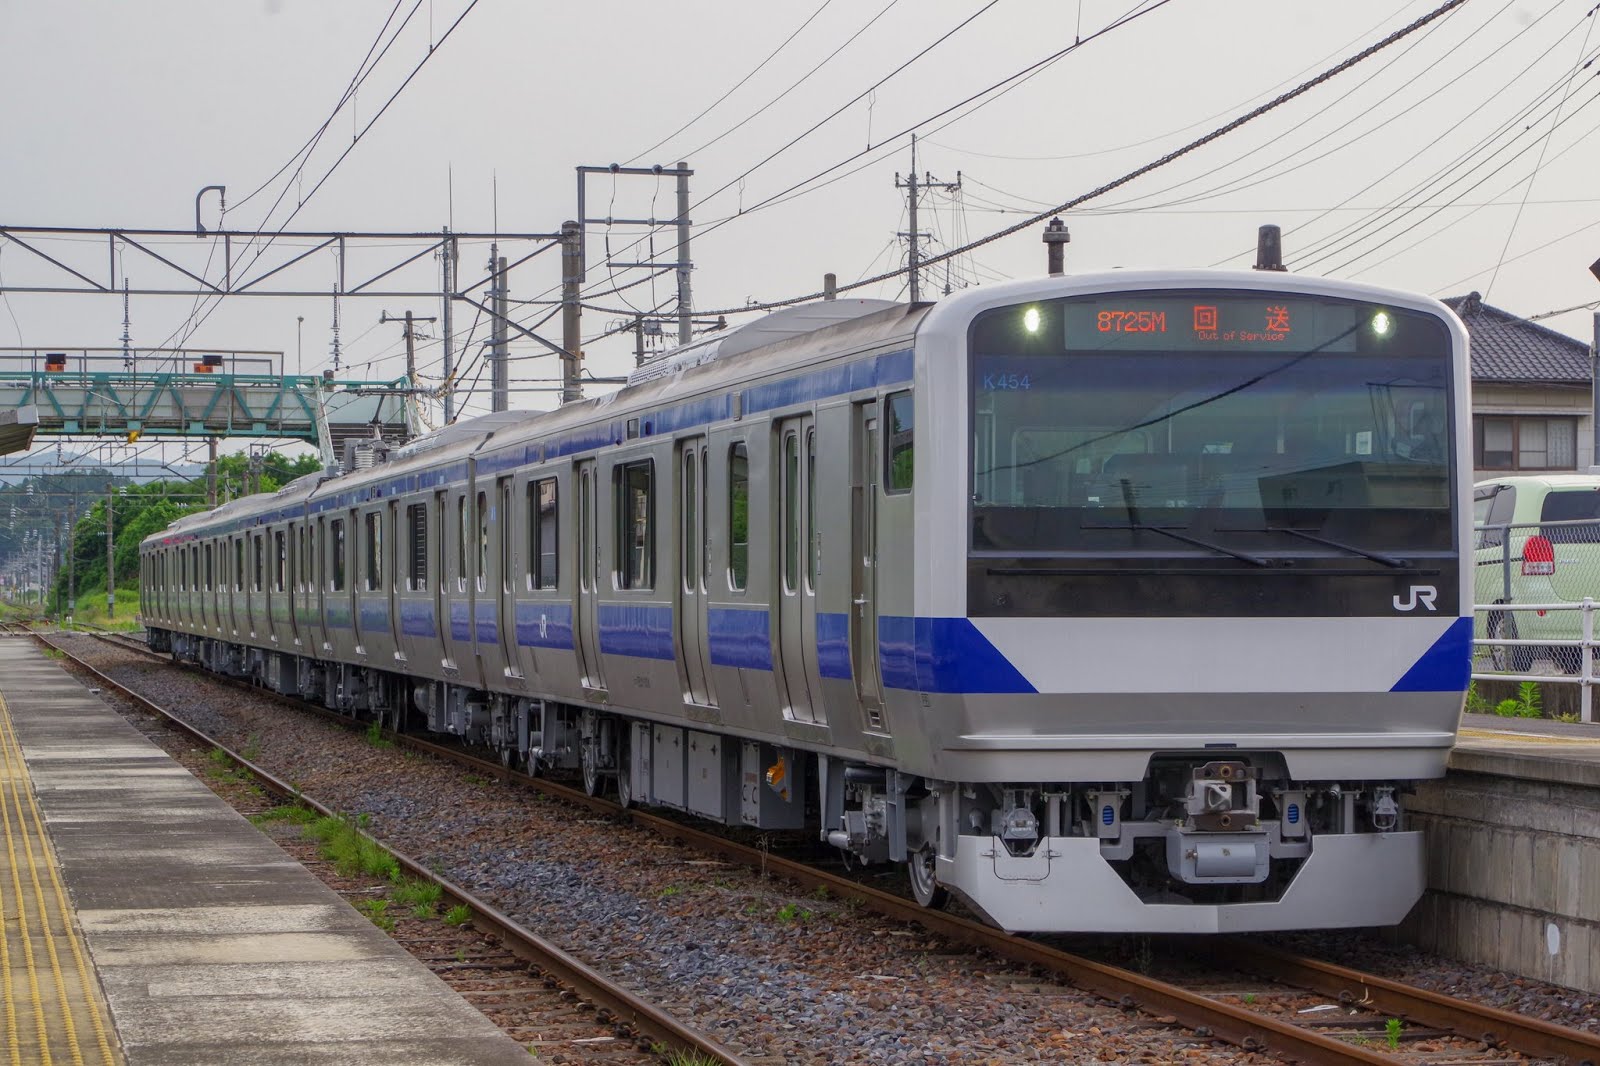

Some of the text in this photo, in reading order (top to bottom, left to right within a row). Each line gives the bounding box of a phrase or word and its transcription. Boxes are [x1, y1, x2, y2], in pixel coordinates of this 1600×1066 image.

[1097, 311, 1167, 332] 8725M
[1198, 331, 1286, 341] Out of Service
[984, 374, 1031, 390] K454
[1393, 585, 1437, 611] JR
[539, 613, 548, 639] JR
